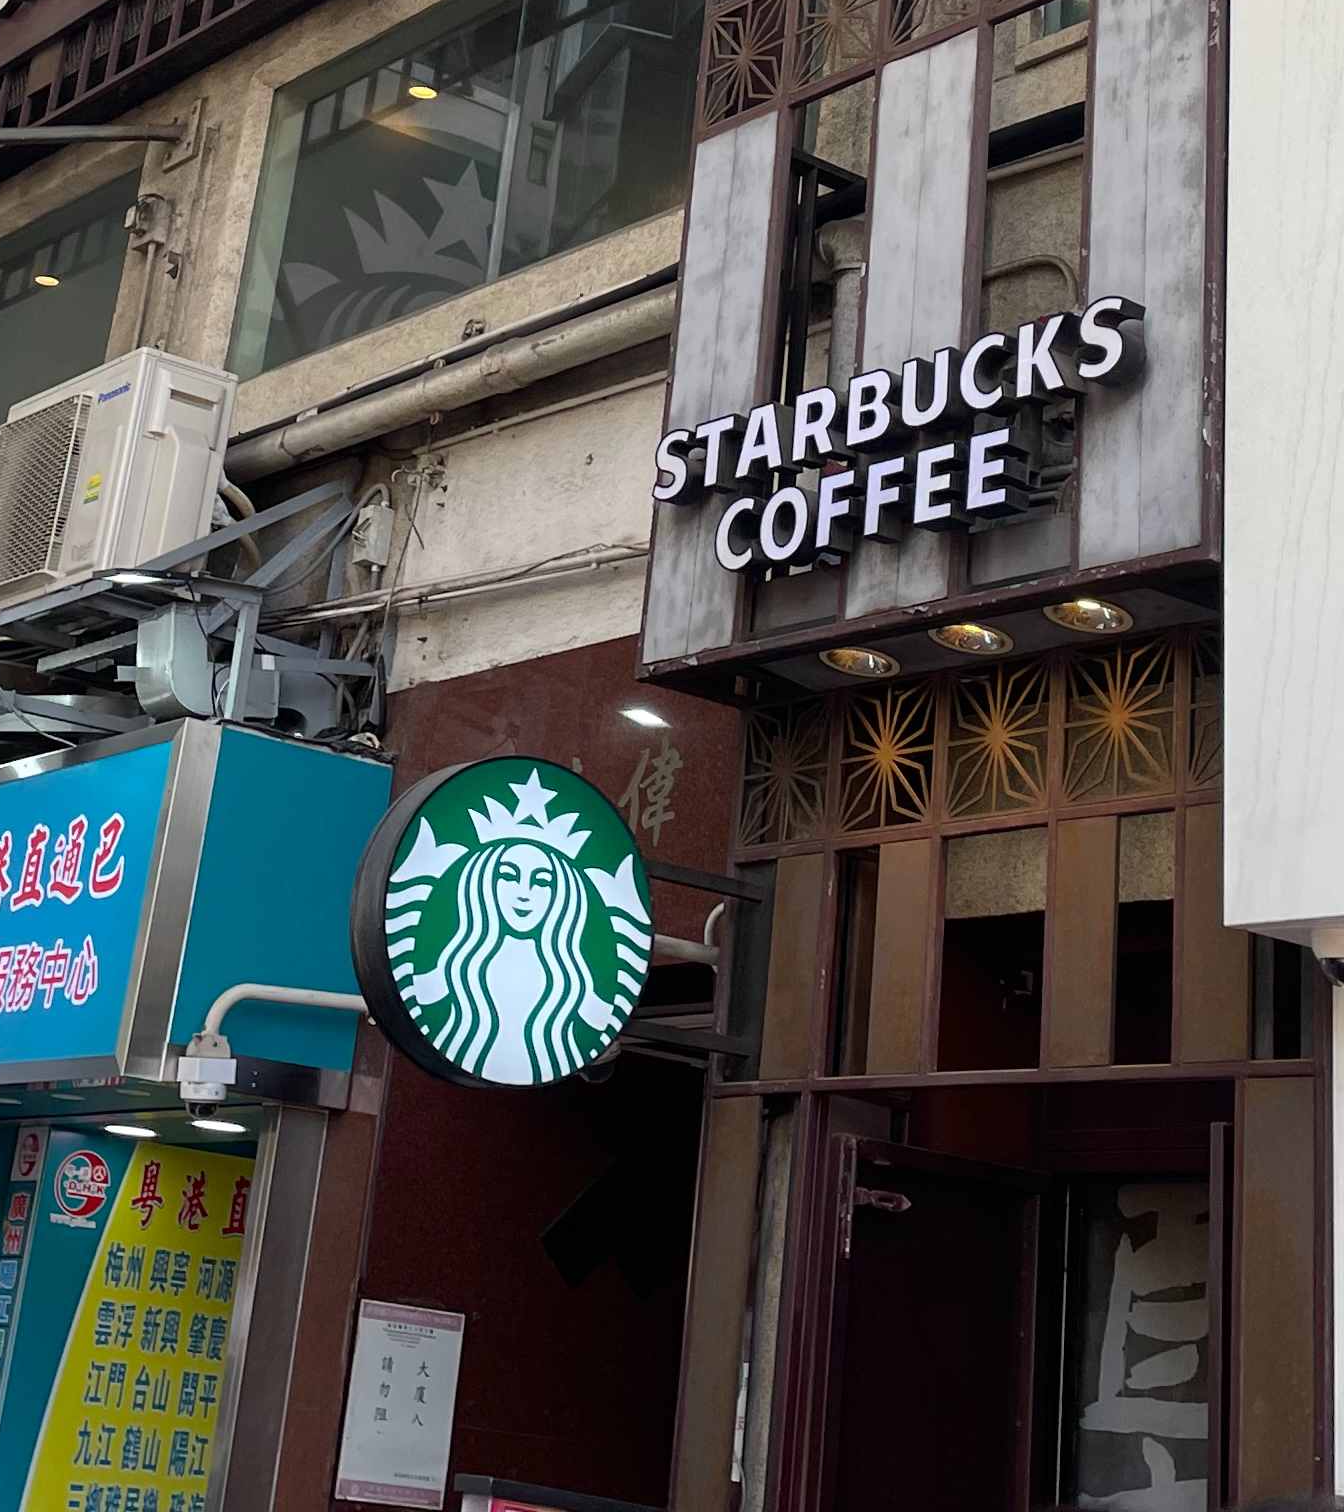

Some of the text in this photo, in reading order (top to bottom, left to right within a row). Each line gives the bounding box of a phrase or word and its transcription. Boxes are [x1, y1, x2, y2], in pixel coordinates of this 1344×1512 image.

[653, 296, 1134, 501] STARBUCKS
[715, 427, 1012, 571] COFFEE
[83, 1361, 128, 1409] 江門
[132, 1364, 171, 1412] 台山
[73, 1419, 117, 1466] 九江
